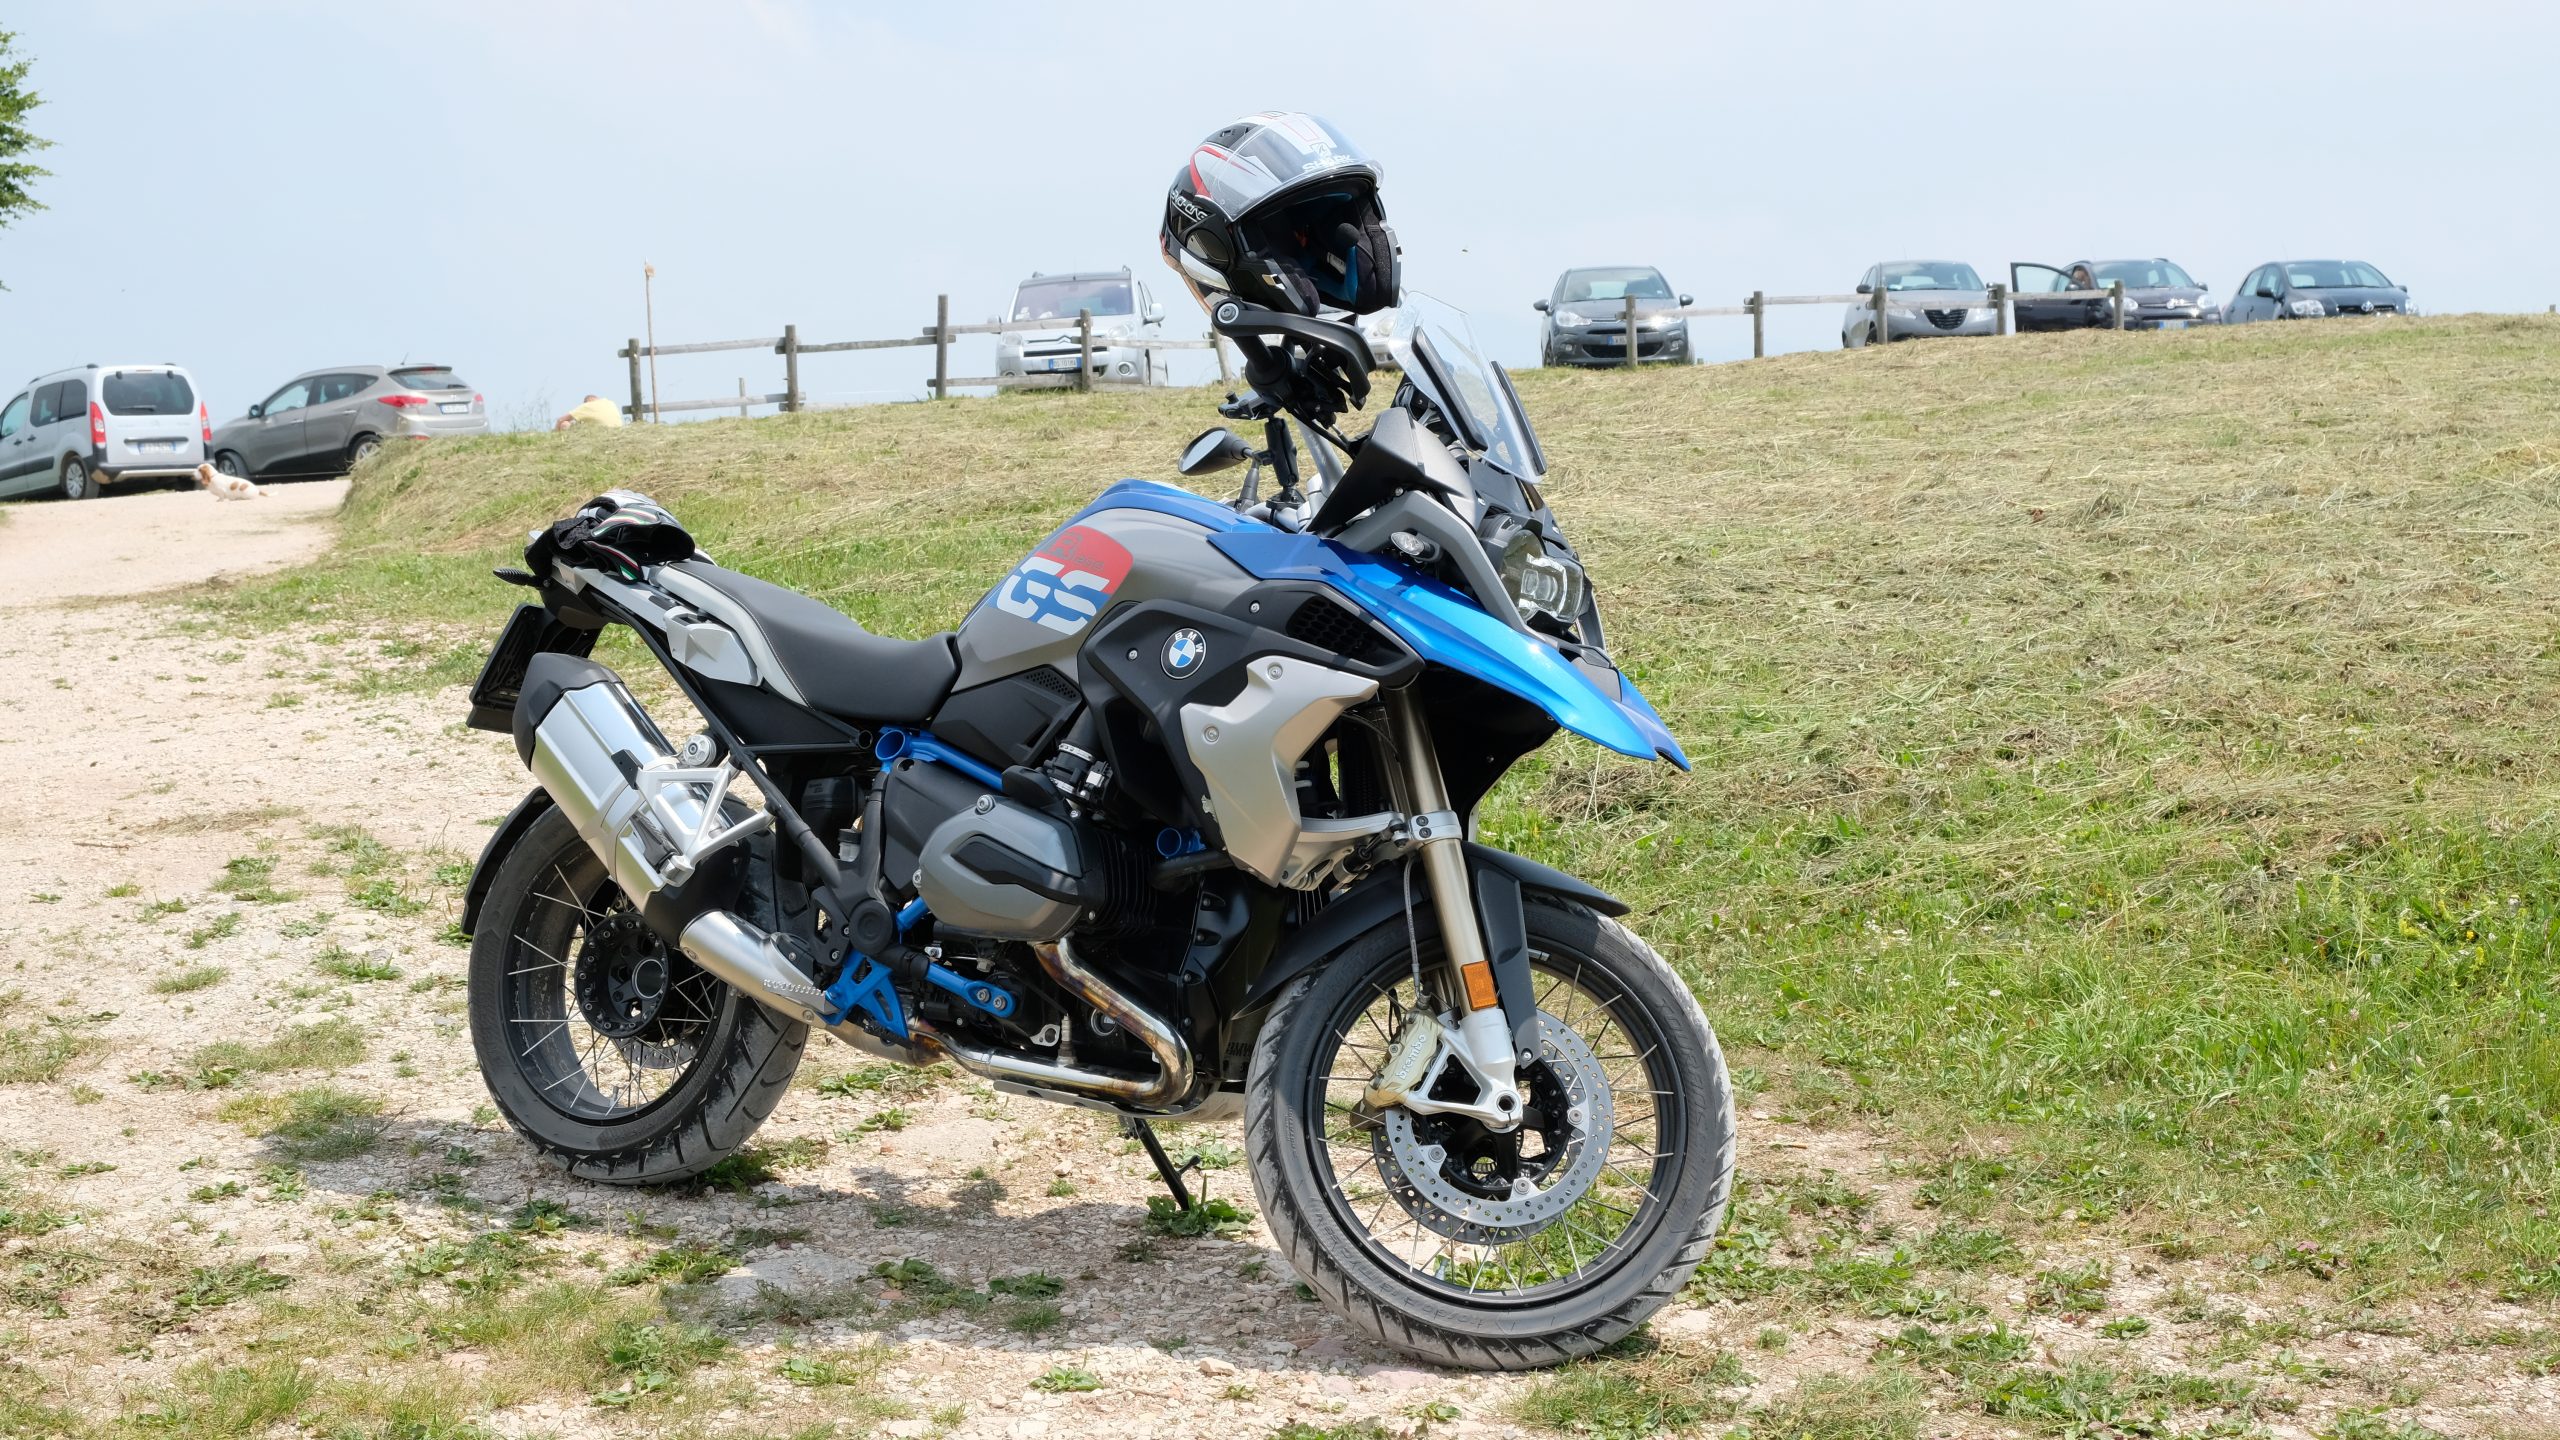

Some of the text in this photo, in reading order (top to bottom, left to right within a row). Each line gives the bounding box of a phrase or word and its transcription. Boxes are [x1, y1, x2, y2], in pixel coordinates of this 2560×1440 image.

[1302, 154, 1353, 171] SHARK
[997, 556, 1110, 636] GS
[1174, 631, 1204, 653] BMW
[1395, 1034, 1425, 1080] brembo
